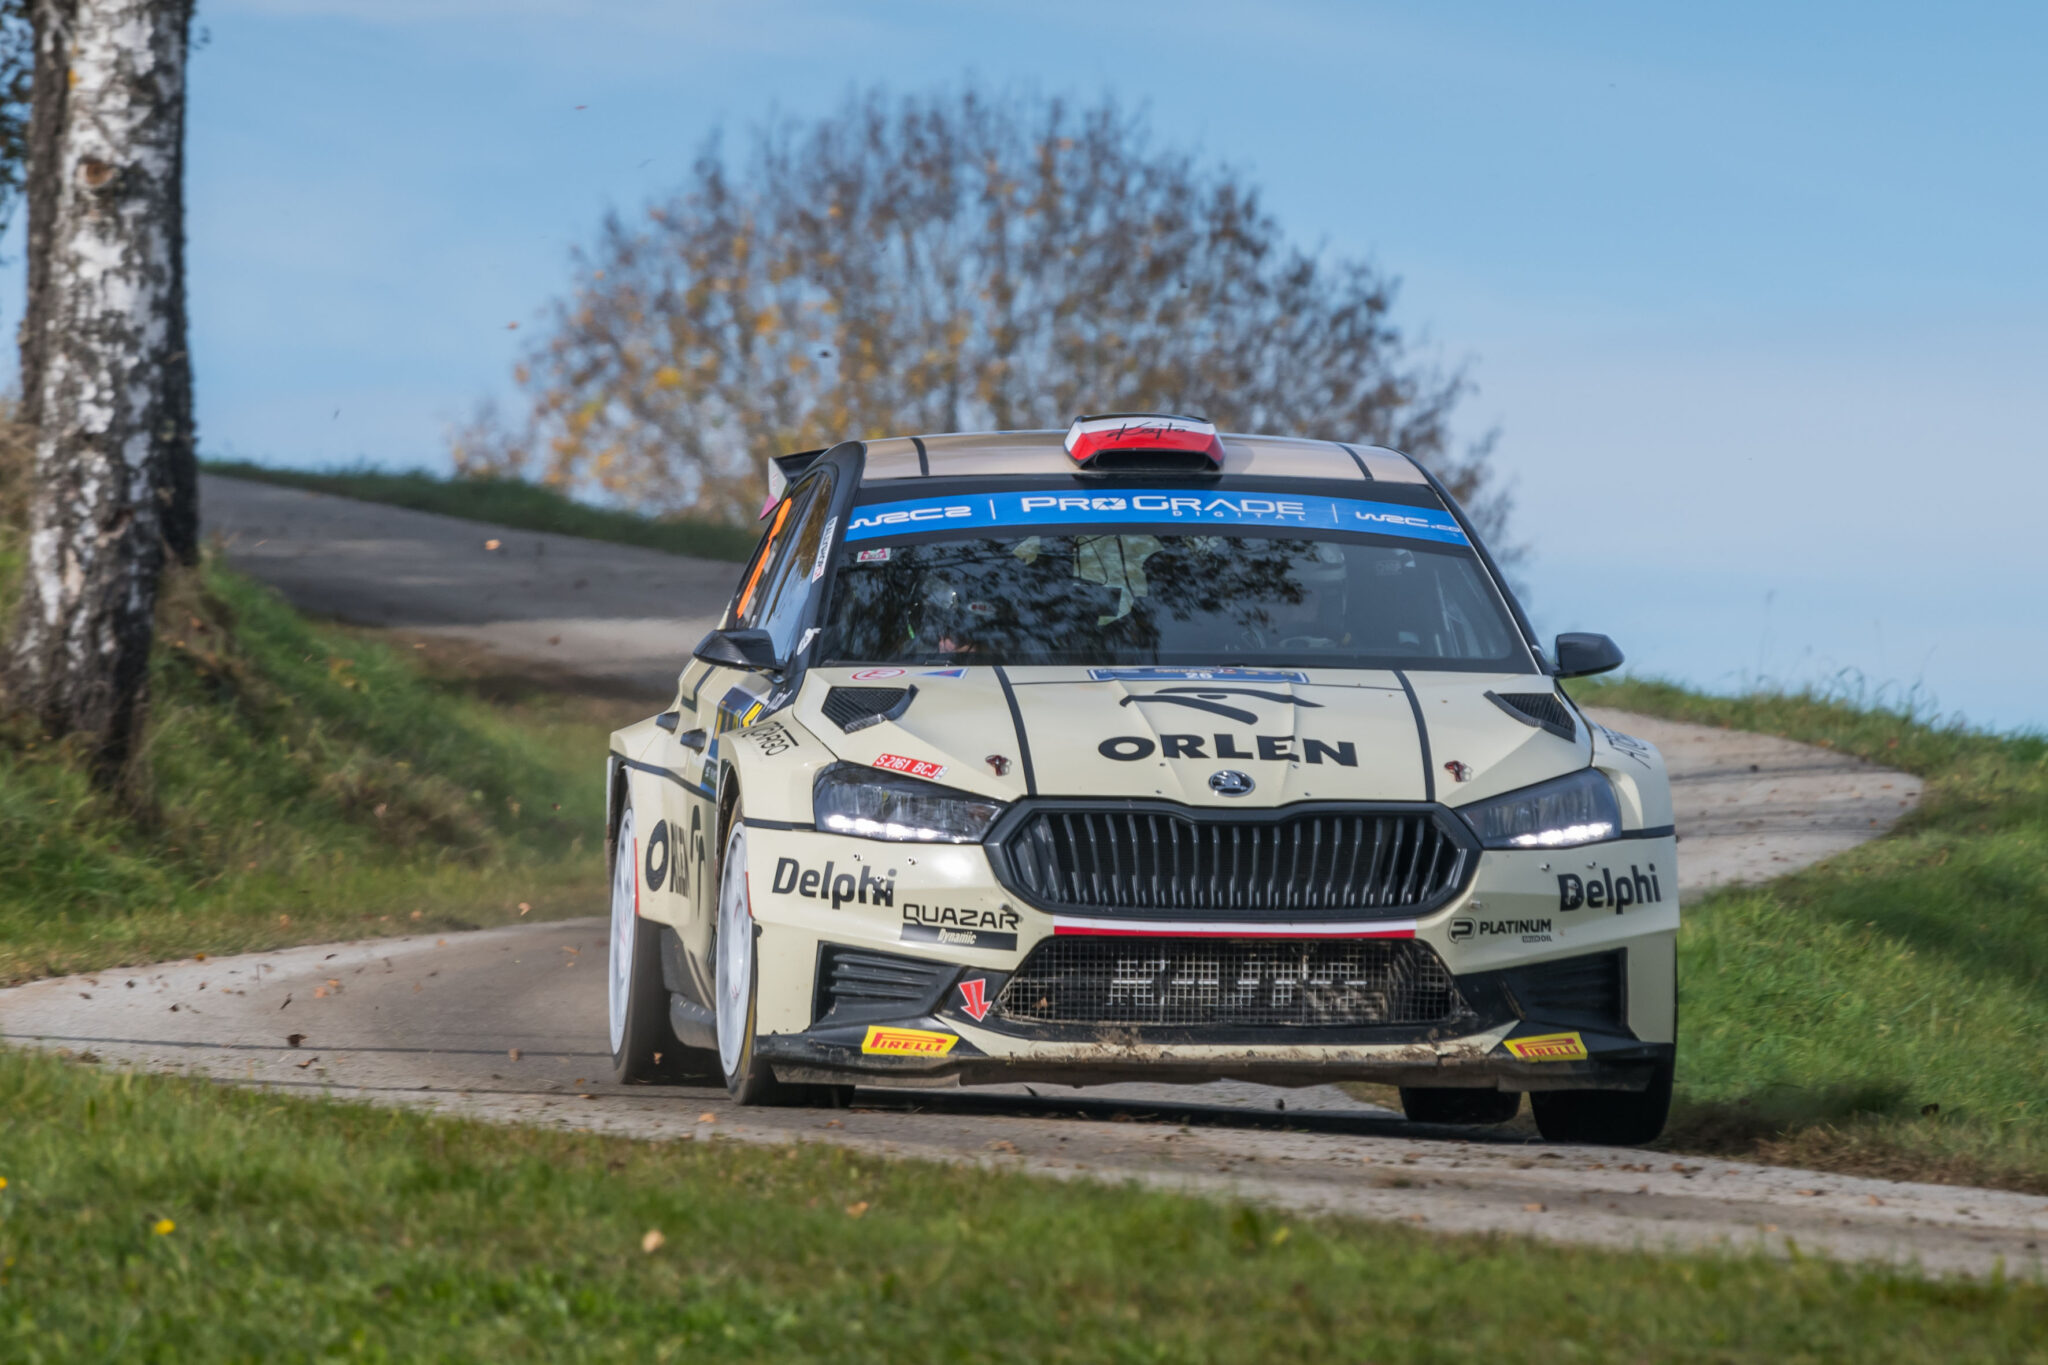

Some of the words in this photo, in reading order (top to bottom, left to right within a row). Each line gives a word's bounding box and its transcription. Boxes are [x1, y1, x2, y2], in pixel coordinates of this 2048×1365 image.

[1173, 510, 1305, 521] DIGITAL
[1098, 733, 1358, 767] ORLEN
[772, 857, 897, 910] Delphi
[1557, 862, 1662, 915] Delphi
[903, 903, 1019, 930] QUAZAR
[1480, 918, 1552, 935] PLATINUM
[937, 928, 977, 945] Dynamic
[871, 1032, 948, 1051] PIRELLI
[1515, 1037, 1580, 1057] PIRELLI
